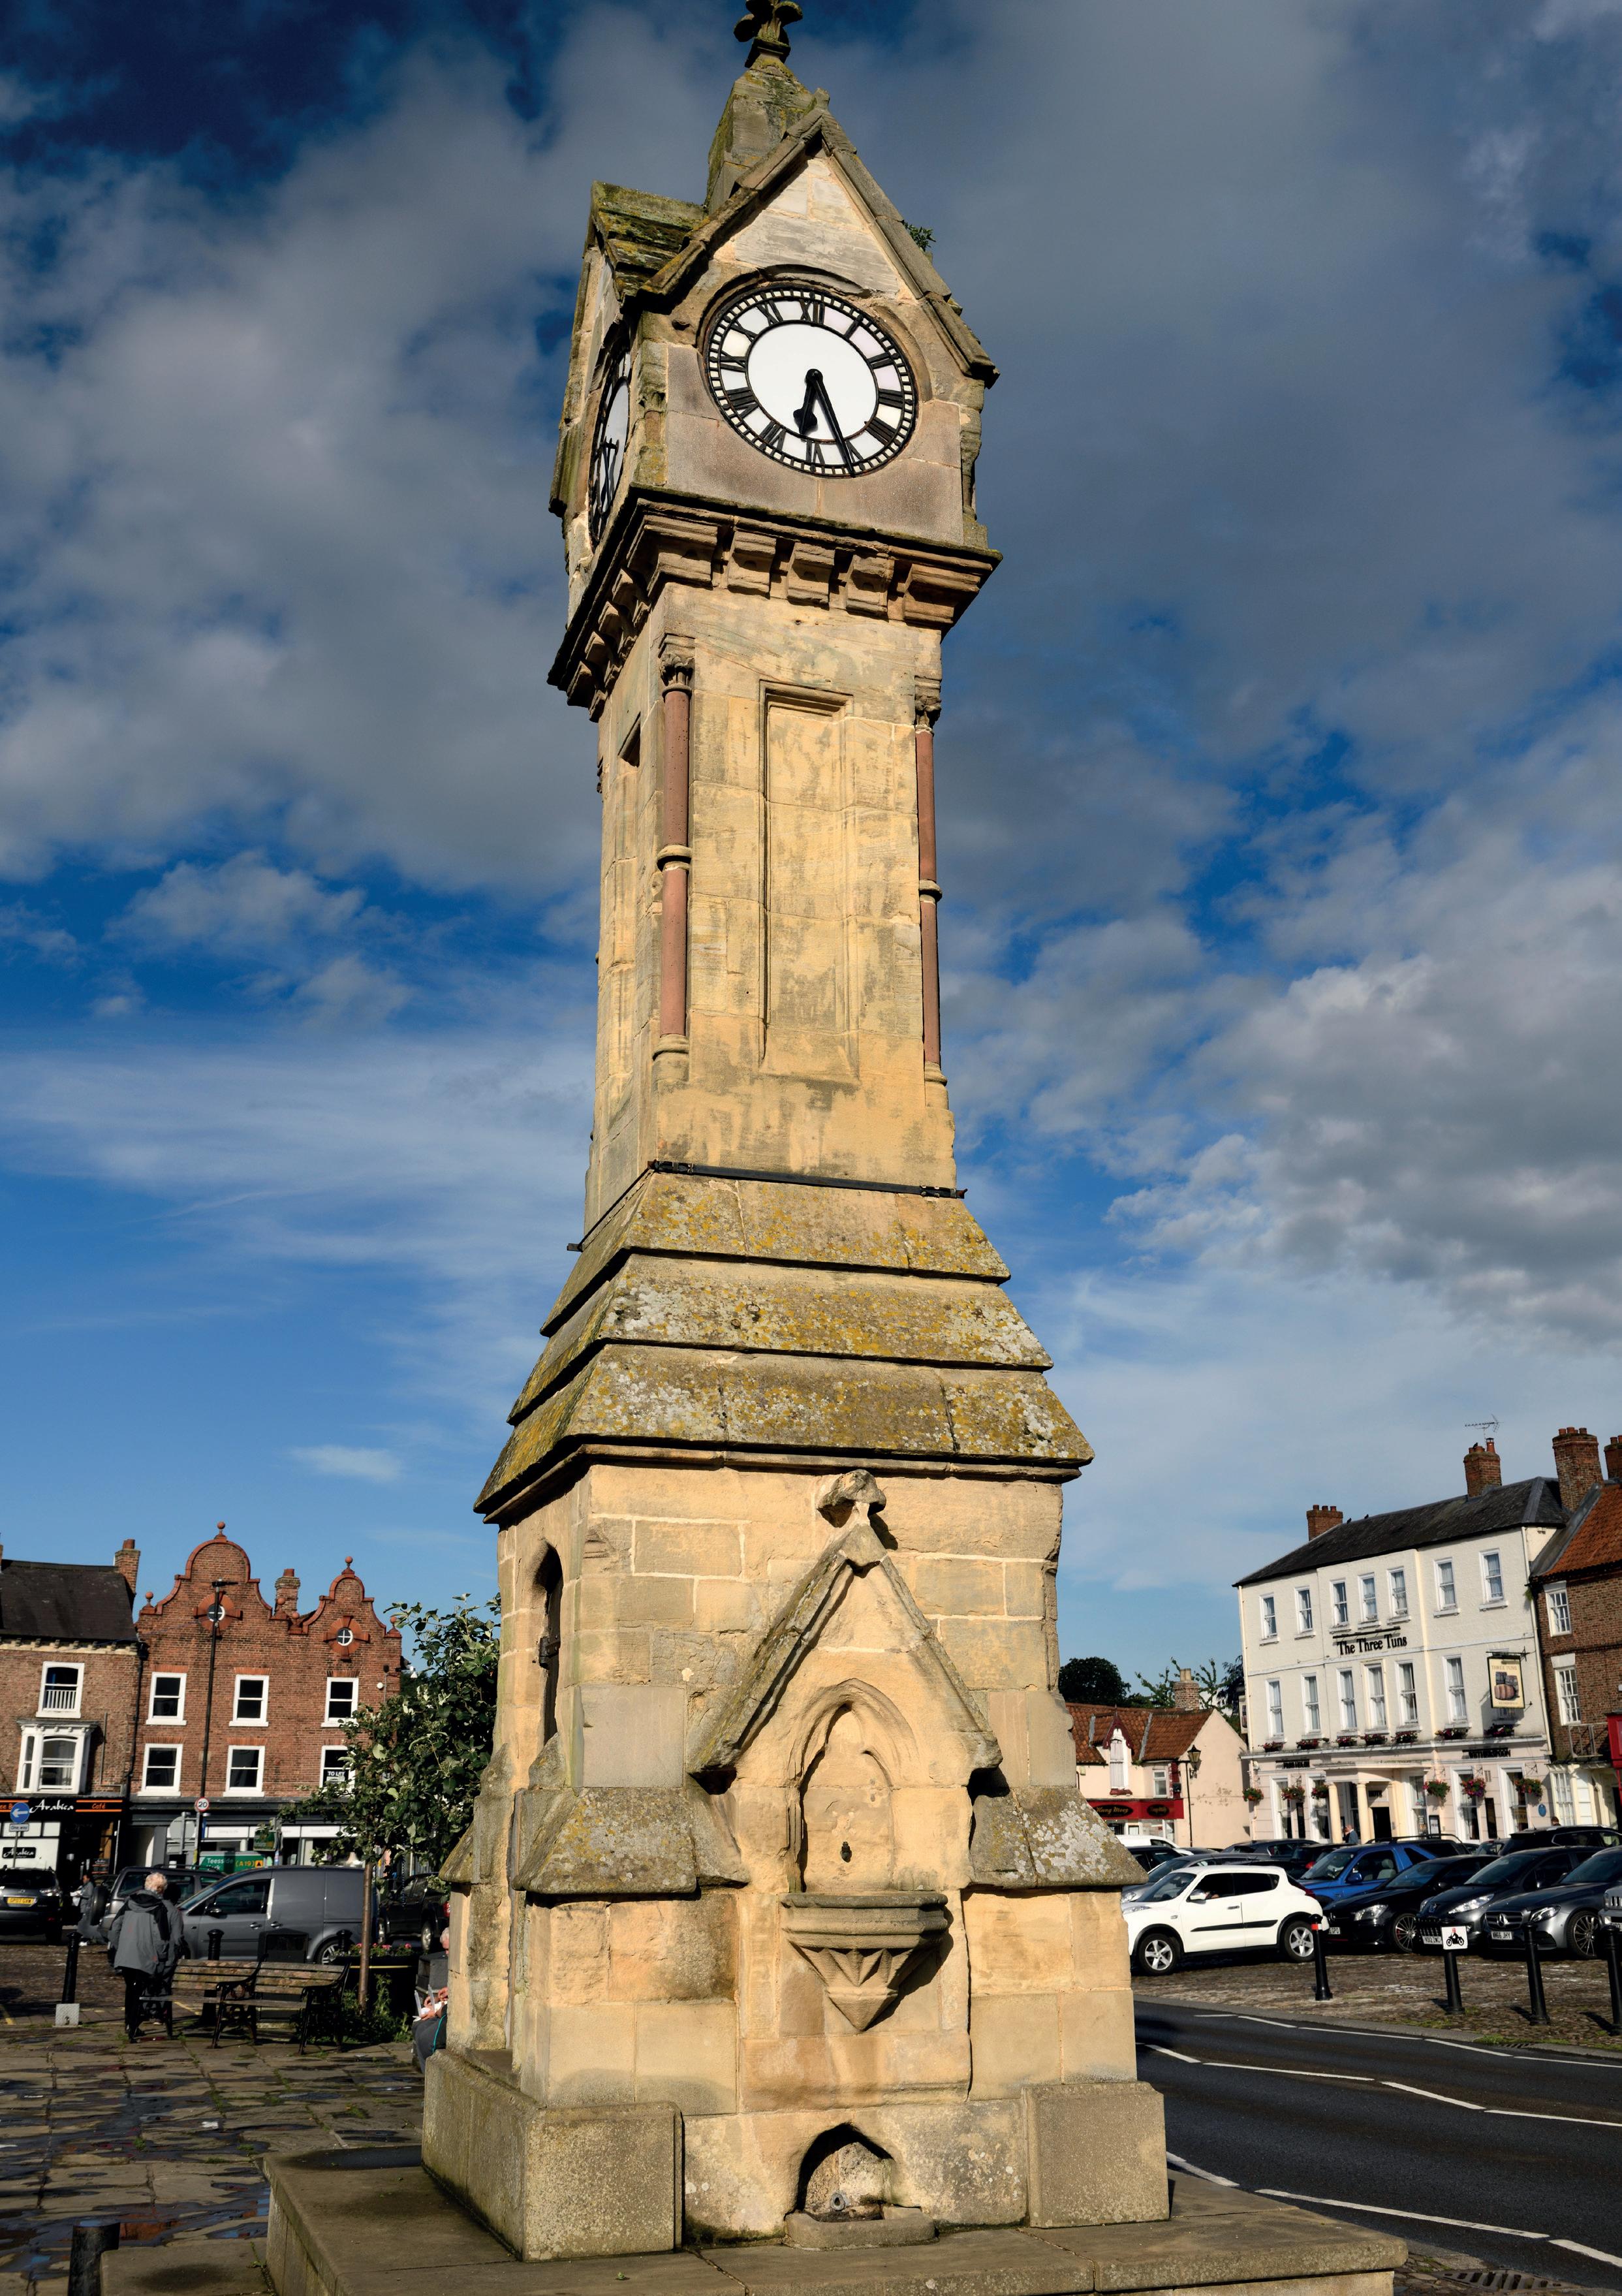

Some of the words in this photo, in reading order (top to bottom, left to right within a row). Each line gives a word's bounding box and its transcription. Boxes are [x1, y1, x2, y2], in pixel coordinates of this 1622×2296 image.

[1337, 1640, 1356, 1655] The
[1356, 1637, 1383, 1653] Three
[1384, 1633, 1407, 1649] Tuns
[29, 1799, 74, 1814] Arabica
